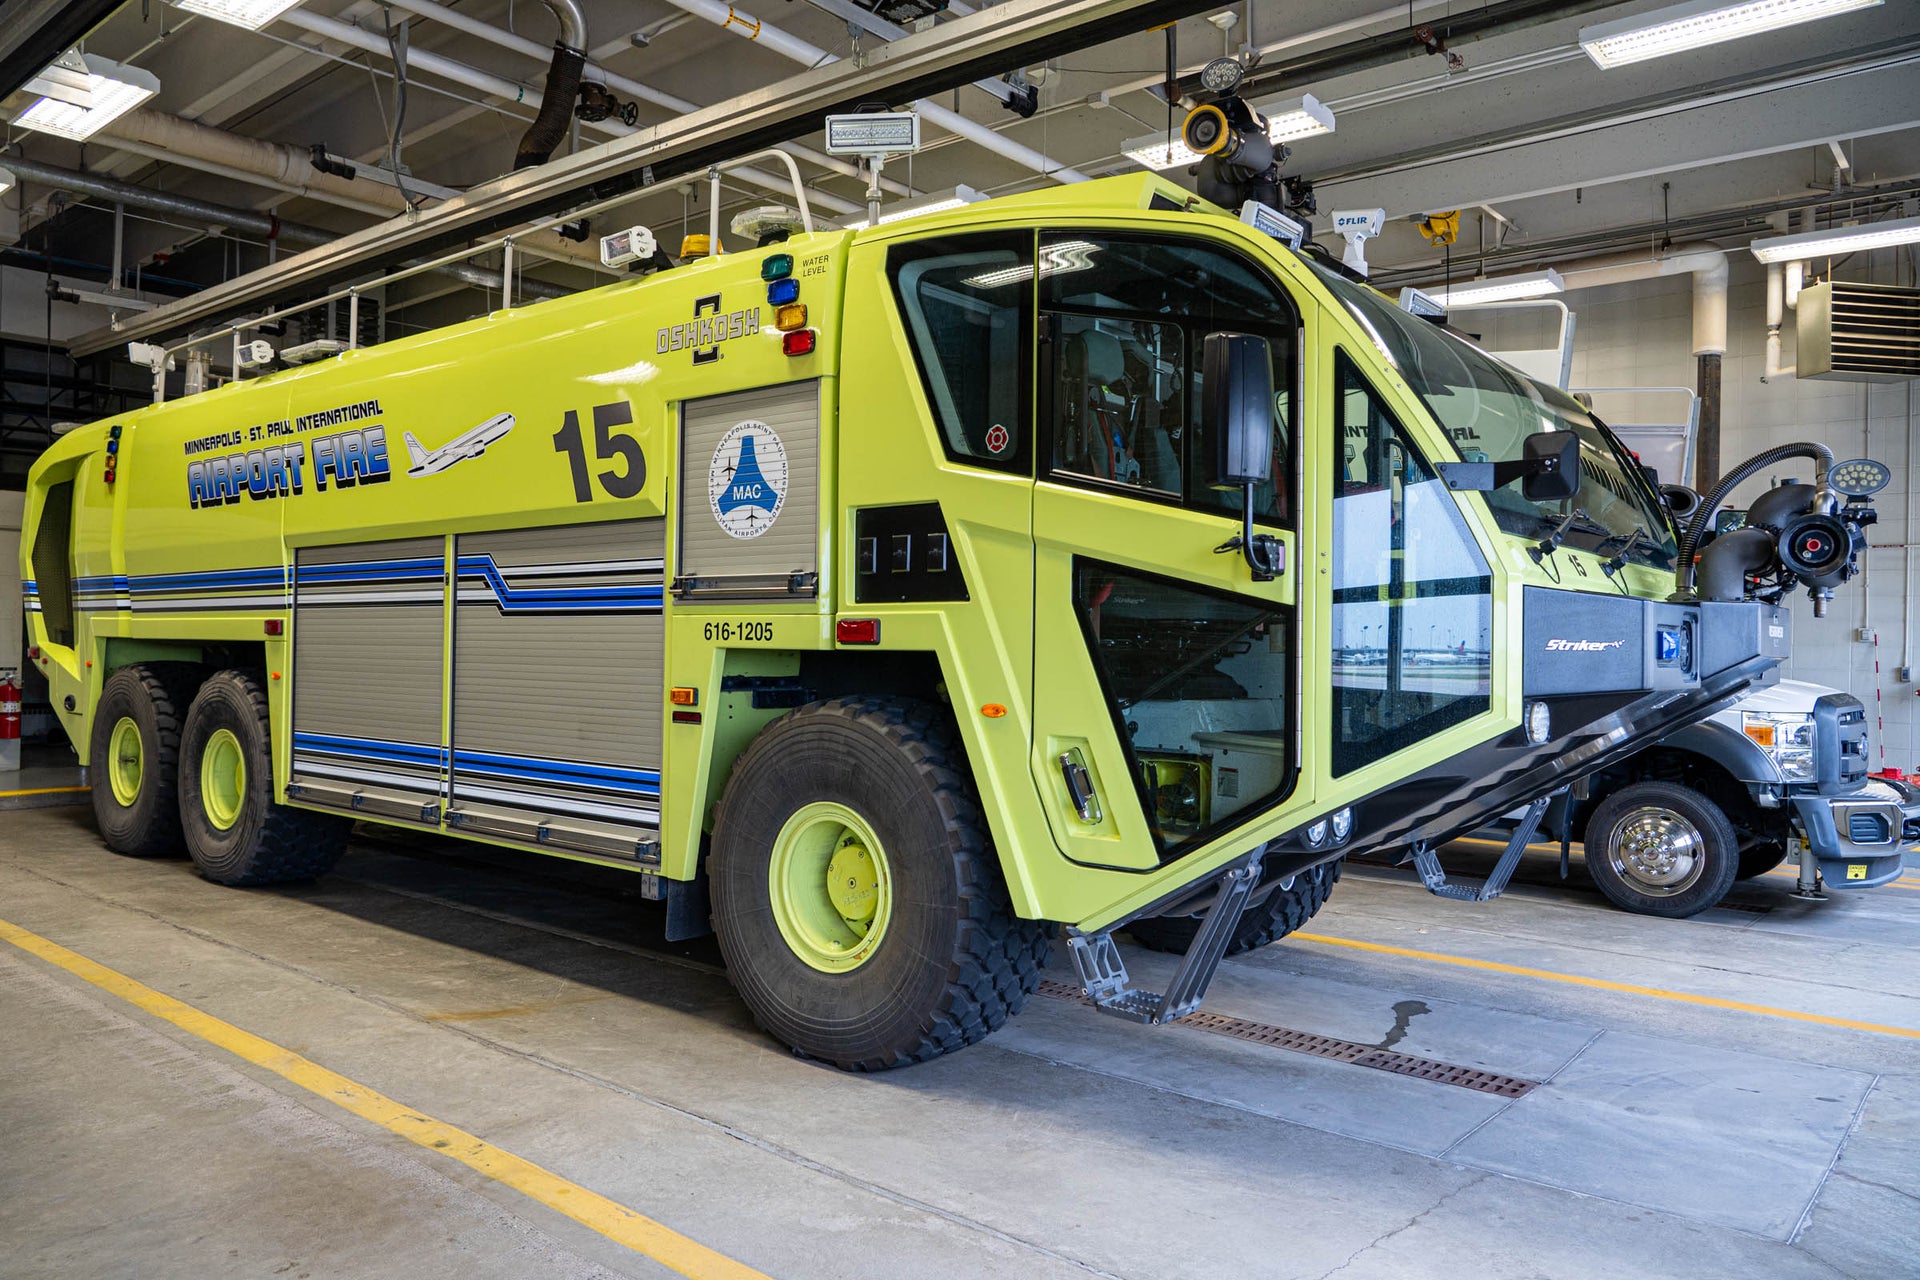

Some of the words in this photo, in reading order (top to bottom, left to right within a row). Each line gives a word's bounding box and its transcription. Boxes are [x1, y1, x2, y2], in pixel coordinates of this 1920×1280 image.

[1346, 216, 1367, 225] FLIR
[802, 254, 829, 268] WATER
[803, 266, 826, 277] LEVEL
[656, 307, 760, 354] OSHKOSH
[184, 430, 242, 456] MINNEAPOLIS
[249, 425, 265, 441] ST.
[267, 419, 294, 437] PAUL
[296, 399, 384, 432] INTERNATIONAL
[552, 400, 647, 503] 15
[187, 441, 305, 510] AIRPORT
[311, 424, 391, 493] FIRE
[710, 470, 733, 532] METROPOLITAN
[733, 484, 761, 501] MAC
[768, 462, 787, 523] COMMISSION
[734, 523, 767, 537] AIRPORTS
[1567, 553, 1587, 577] 15
[704, 622, 773, 641] 616-1205
[1545, 638, 1611, 651] Striker
